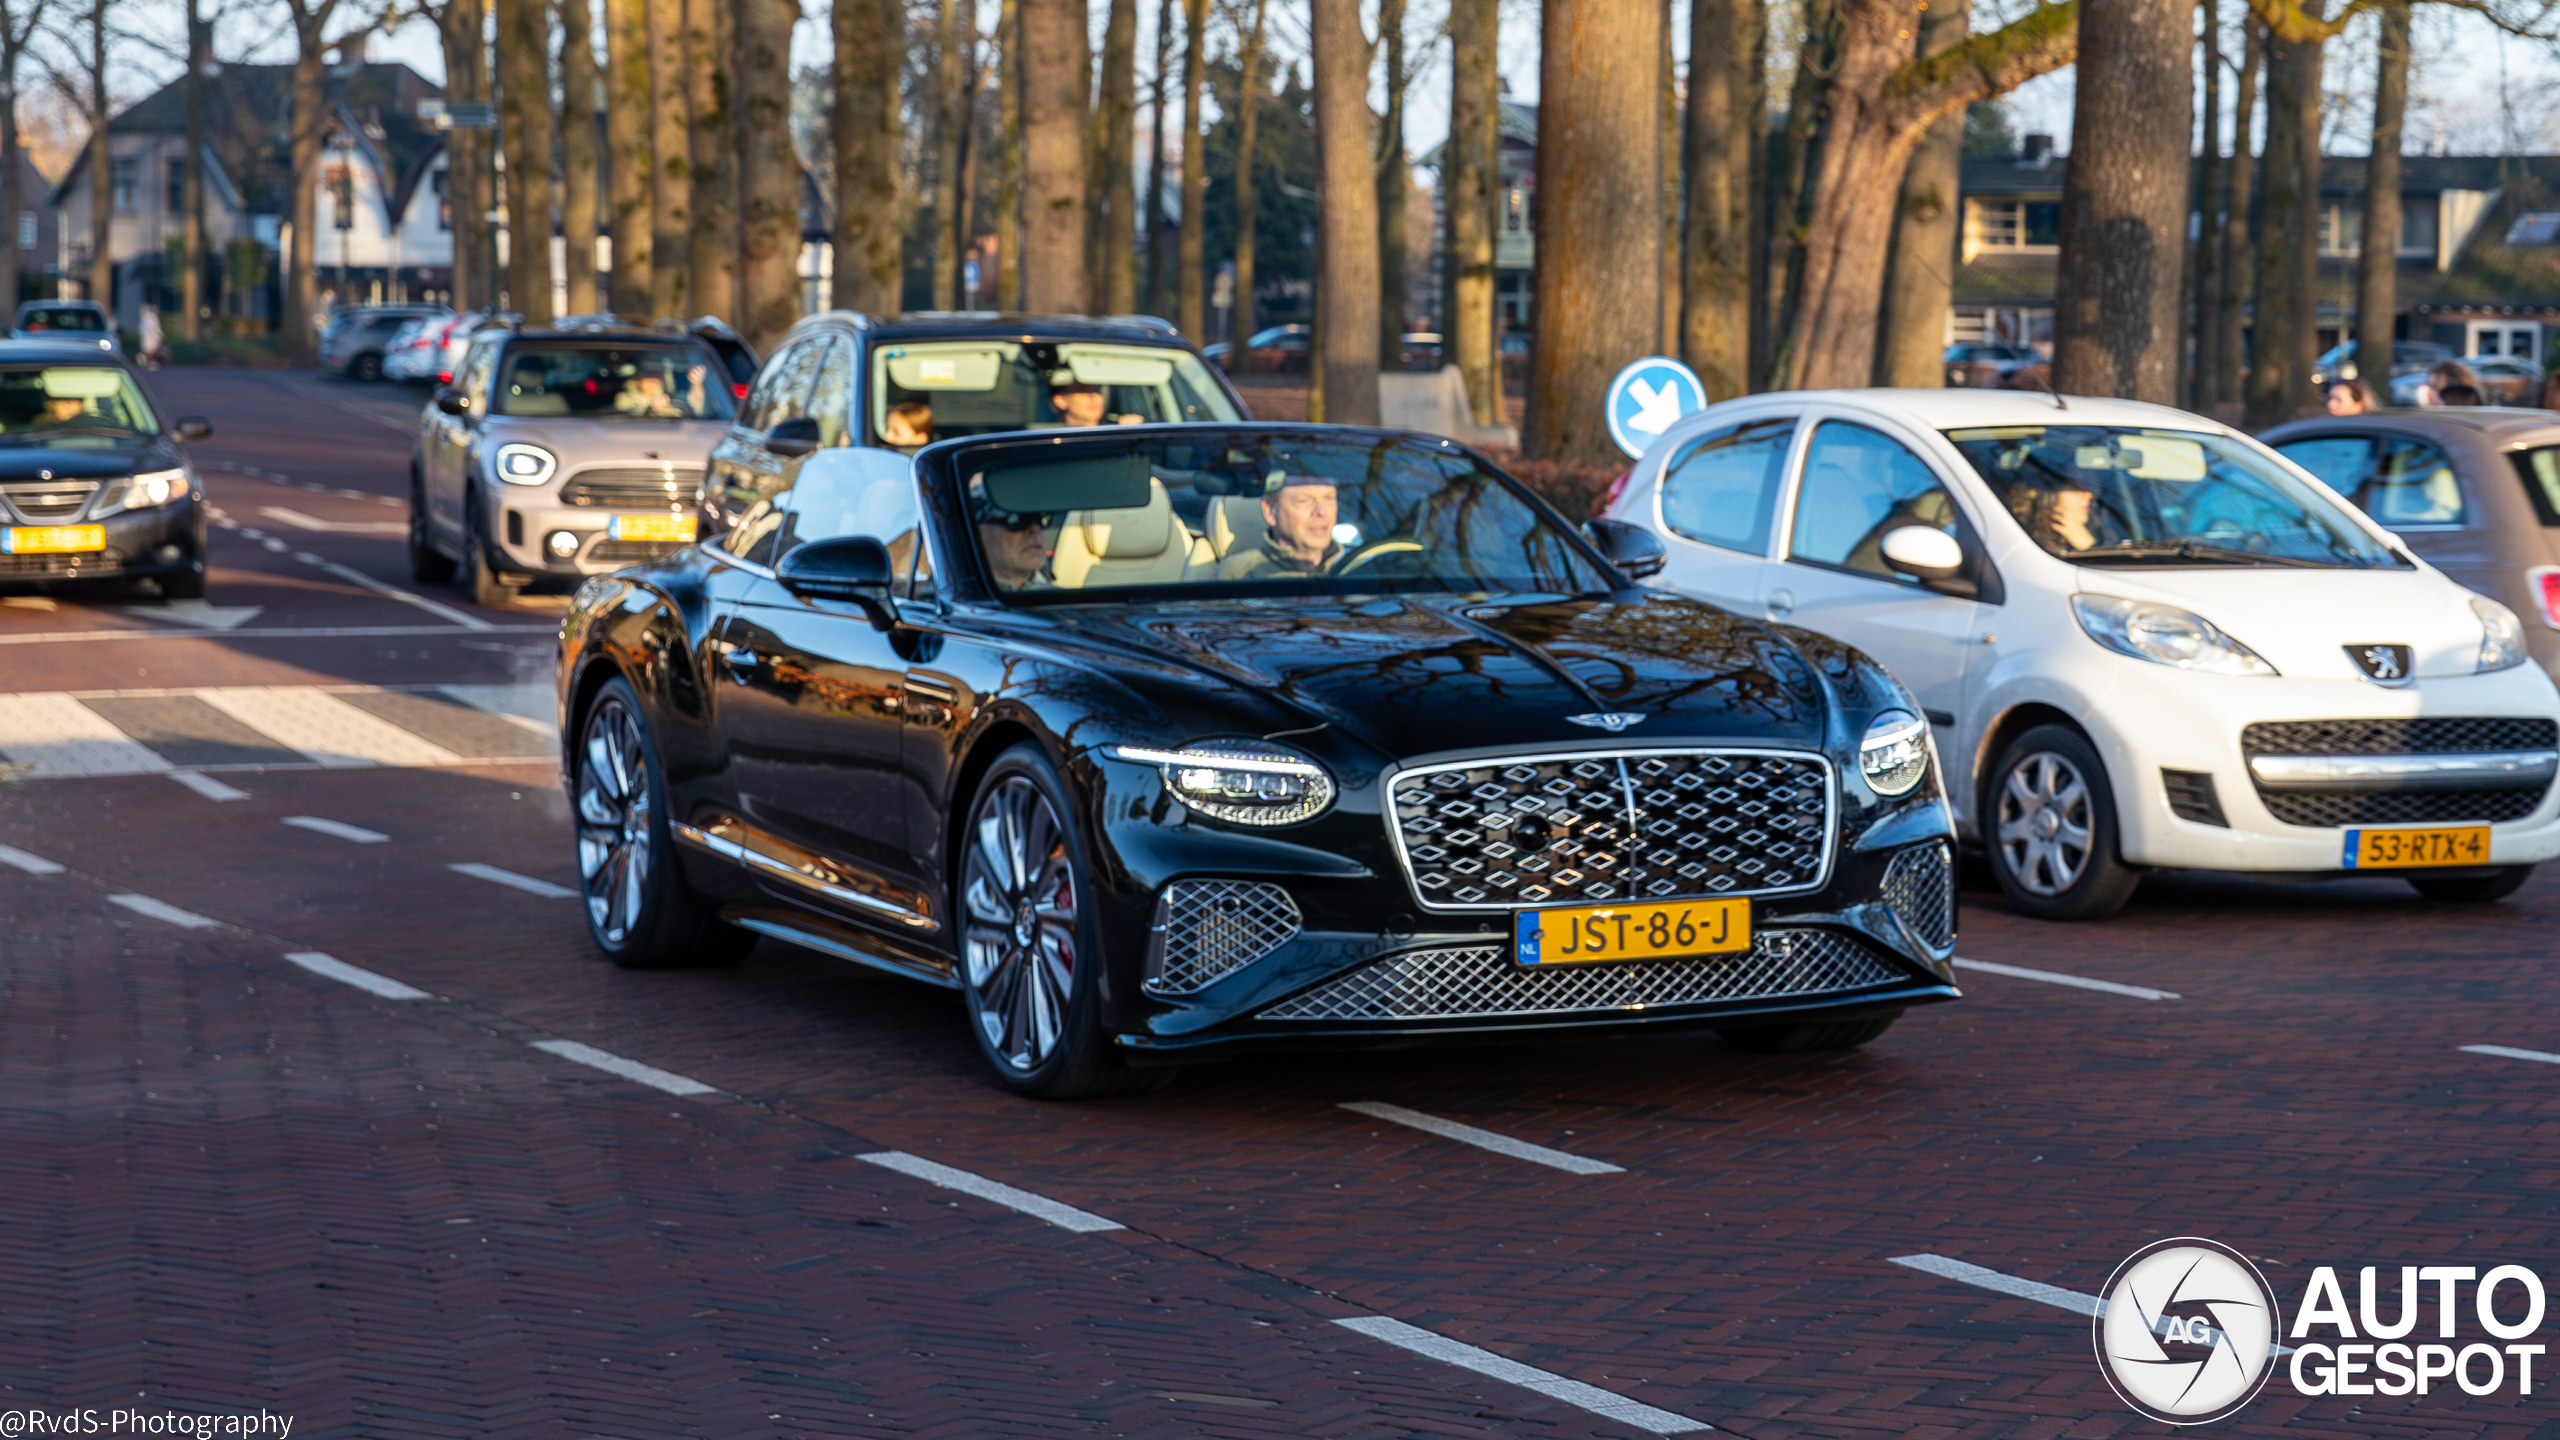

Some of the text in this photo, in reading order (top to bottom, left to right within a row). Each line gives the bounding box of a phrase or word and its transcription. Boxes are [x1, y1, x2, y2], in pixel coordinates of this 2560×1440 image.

[2368, 832, 2482, 862] 53-RTX-4
[1561, 907, 1729, 954] JST-86-J
[1520, 944, 1538, 956] NL
